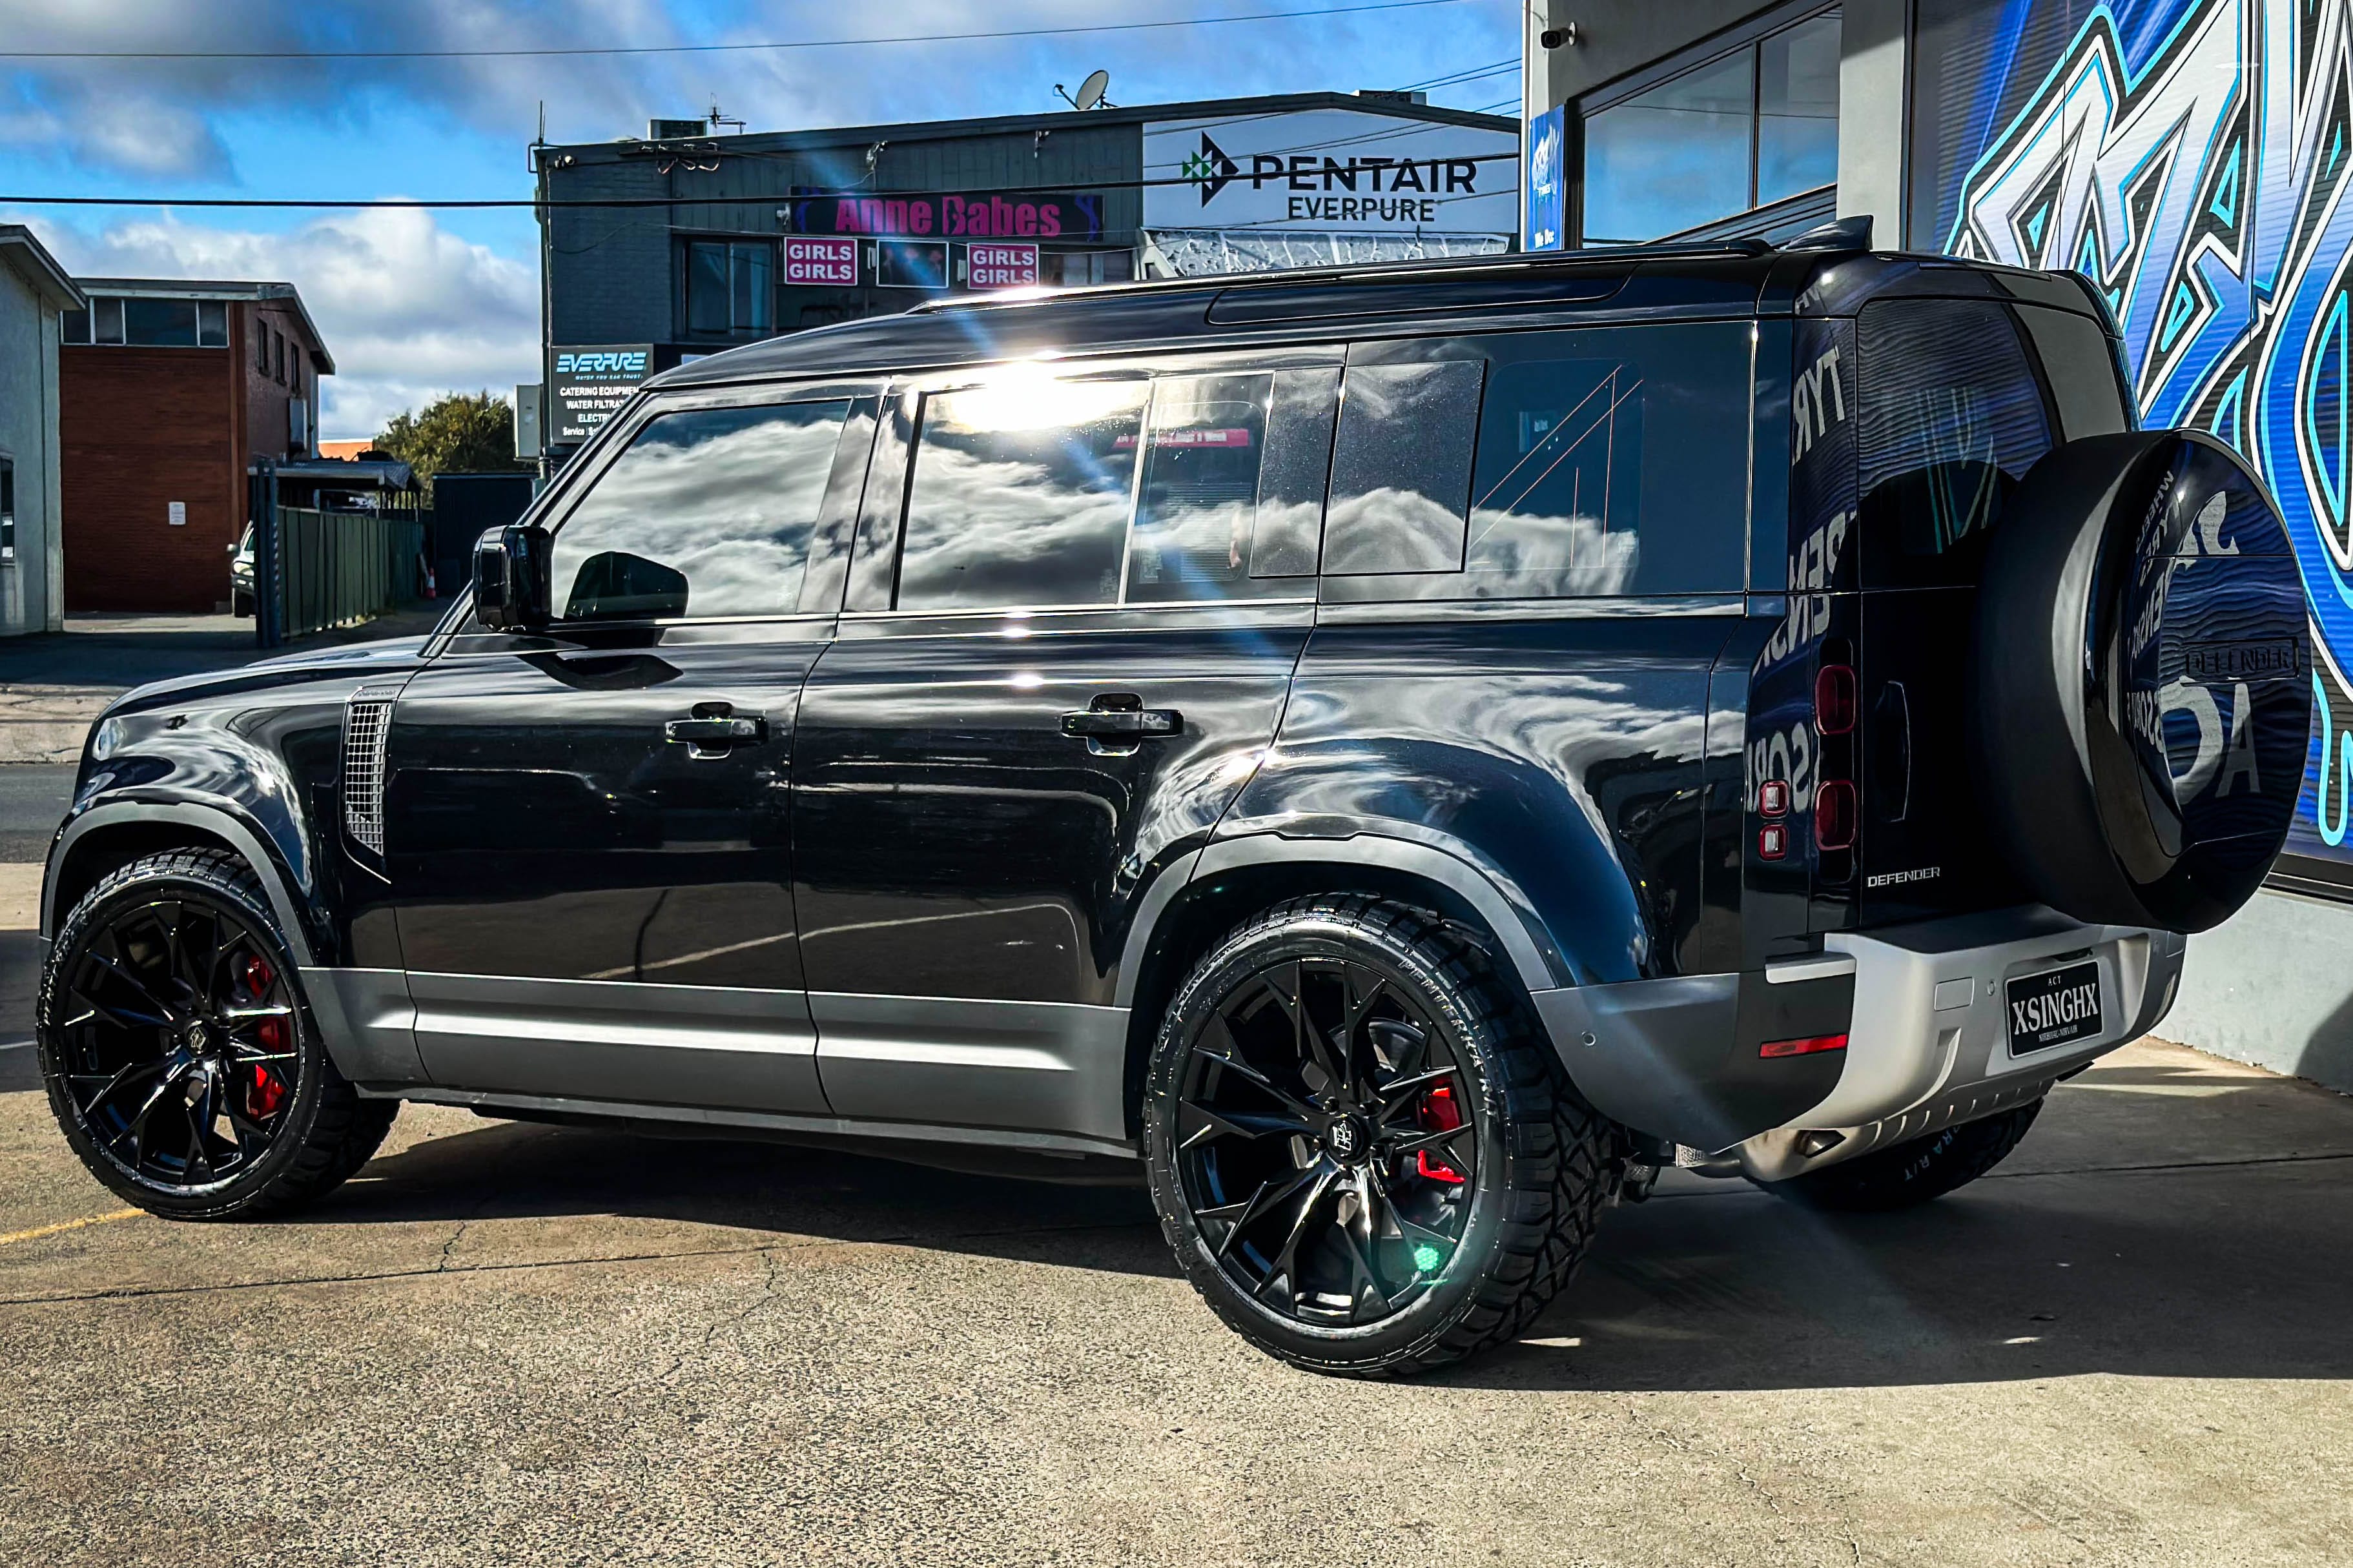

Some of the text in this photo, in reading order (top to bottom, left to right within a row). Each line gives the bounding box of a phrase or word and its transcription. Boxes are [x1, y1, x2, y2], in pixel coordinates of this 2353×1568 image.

[1253, 155, 1477, 194] PENTAIR
[942, 196, 1061, 237] Babes
[1289, 196, 1435, 223] EVERPURE
[789, 244, 852, 261] GIRLS
[972, 249, 1034, 266] GIRLS
[789, 263, 852, 281] GIRLS
[972, 268, 1034, 285] GIRLS
[557, 352, 647, 372] EVERPURE
[560, 386, 639, 397] CATERING EQUIPMEN
[566, 400, 593, 409] WATER
[563, 426, 585, 436] Service
[1867, 866, 1940, 888] DEFENDER
[2012, 983, 2099, 1035] XSINGHX
